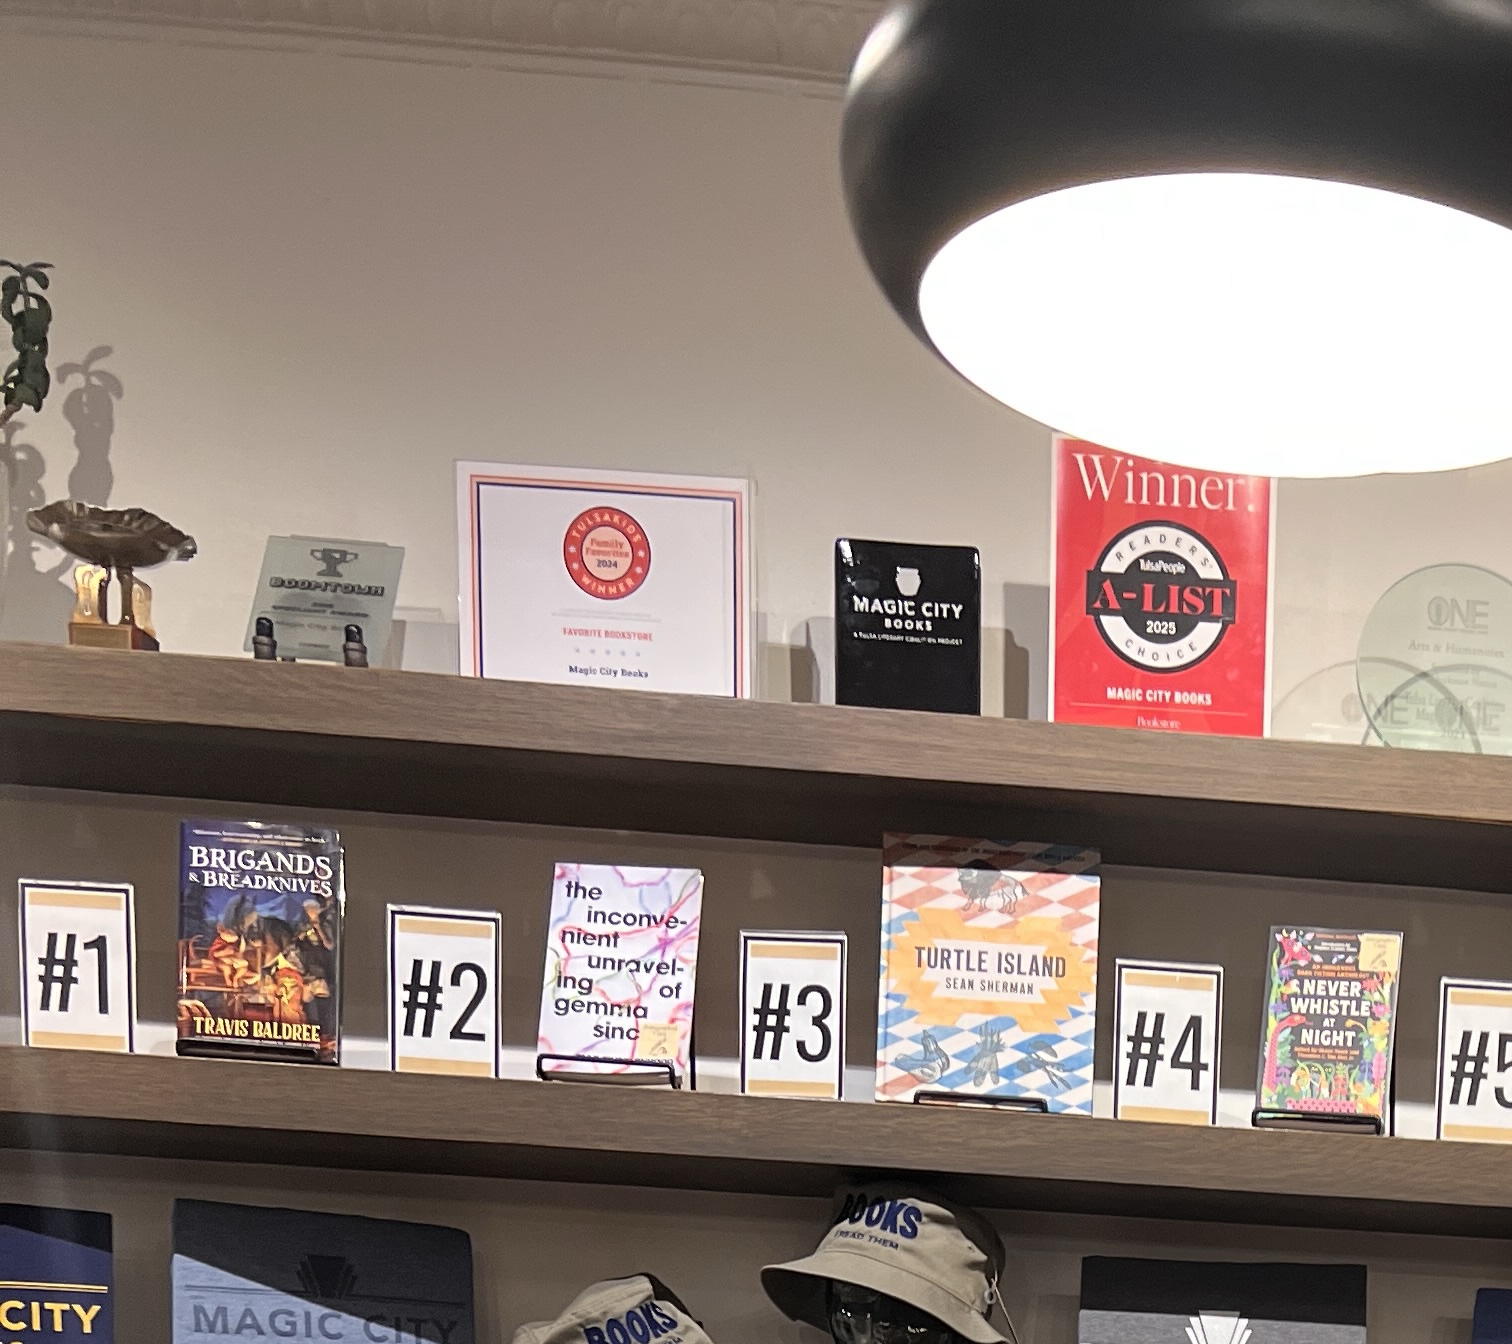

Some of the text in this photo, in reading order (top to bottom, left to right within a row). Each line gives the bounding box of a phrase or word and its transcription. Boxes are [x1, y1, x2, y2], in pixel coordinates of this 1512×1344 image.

[581, 576, 636, 596] WINNER
[852, 595, 964, 620] MAGIC CITY
[1092, 578, 1230, 618] A-LIST
[884, 618, 933, 632] BOOKS
[1146, 620, 1177, 636] 2025
[1125, 638, 1198, 662] CHOICE
[568, 665, 597, 676] Magic
[600, 667, 618, 678] City
[1106, 687, 1212, 706] MAGIC CITY BOOKS
[189, 846, 333, 880] BRIGANDS
[202, 870, 333, 898] BREADKNIVES
[566, 881, 602, 900] the
[586, 906, 687, 929] inconve-
[561, 929, 620, 948] nient
[588, 955, 684, 976] unravel-
[914, 946, 1066, 978] TURTLE ISLAND
[38, 932, 109, 1014] #1
[557, 971, 593, 995] ing
[659, 982, 683, 1000] of
[945, 977, 1034, 995] SEAN SHERMAN
[1303, 979, 1362, 997] NEVER
[403, 958, 488, 1042] #2
[554, 998, 648, 1019] gemma
[1290, 997, 1371, 1017] WHISTLE
[194, 1017, 321, 1043] TRAVIS BALDREE
[753, 982, 833, 1063] #3
[1323, 1017, 1336, 1028] AT
[1300, 1028, 1357, 1048] NIGHT
[1125, 1011, 1209, 1091] #4
[0, 1301, 102, 1334] CITY
